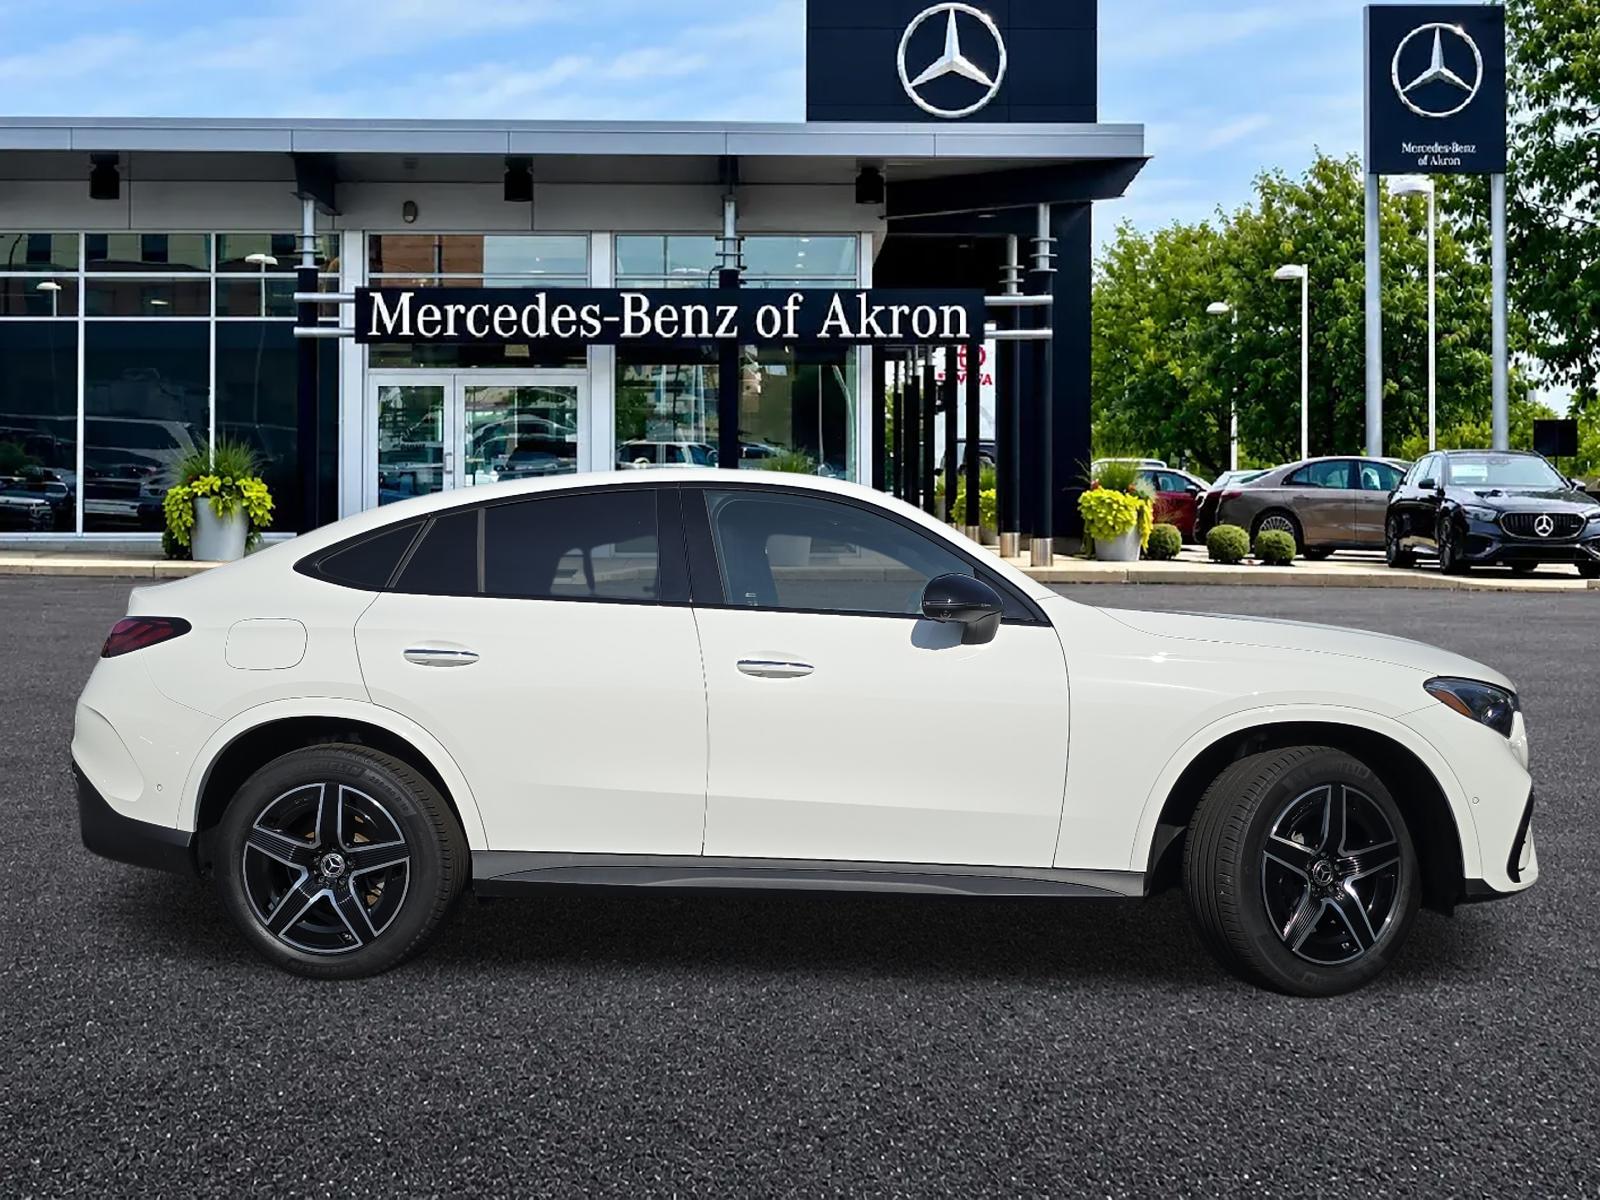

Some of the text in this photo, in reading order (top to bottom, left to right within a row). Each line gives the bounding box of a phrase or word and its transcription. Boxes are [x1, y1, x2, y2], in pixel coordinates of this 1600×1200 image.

[1417, 154, 1461, 166] of Akron
[367, 291, 970, 339] Mercedes-Benz of Akron
